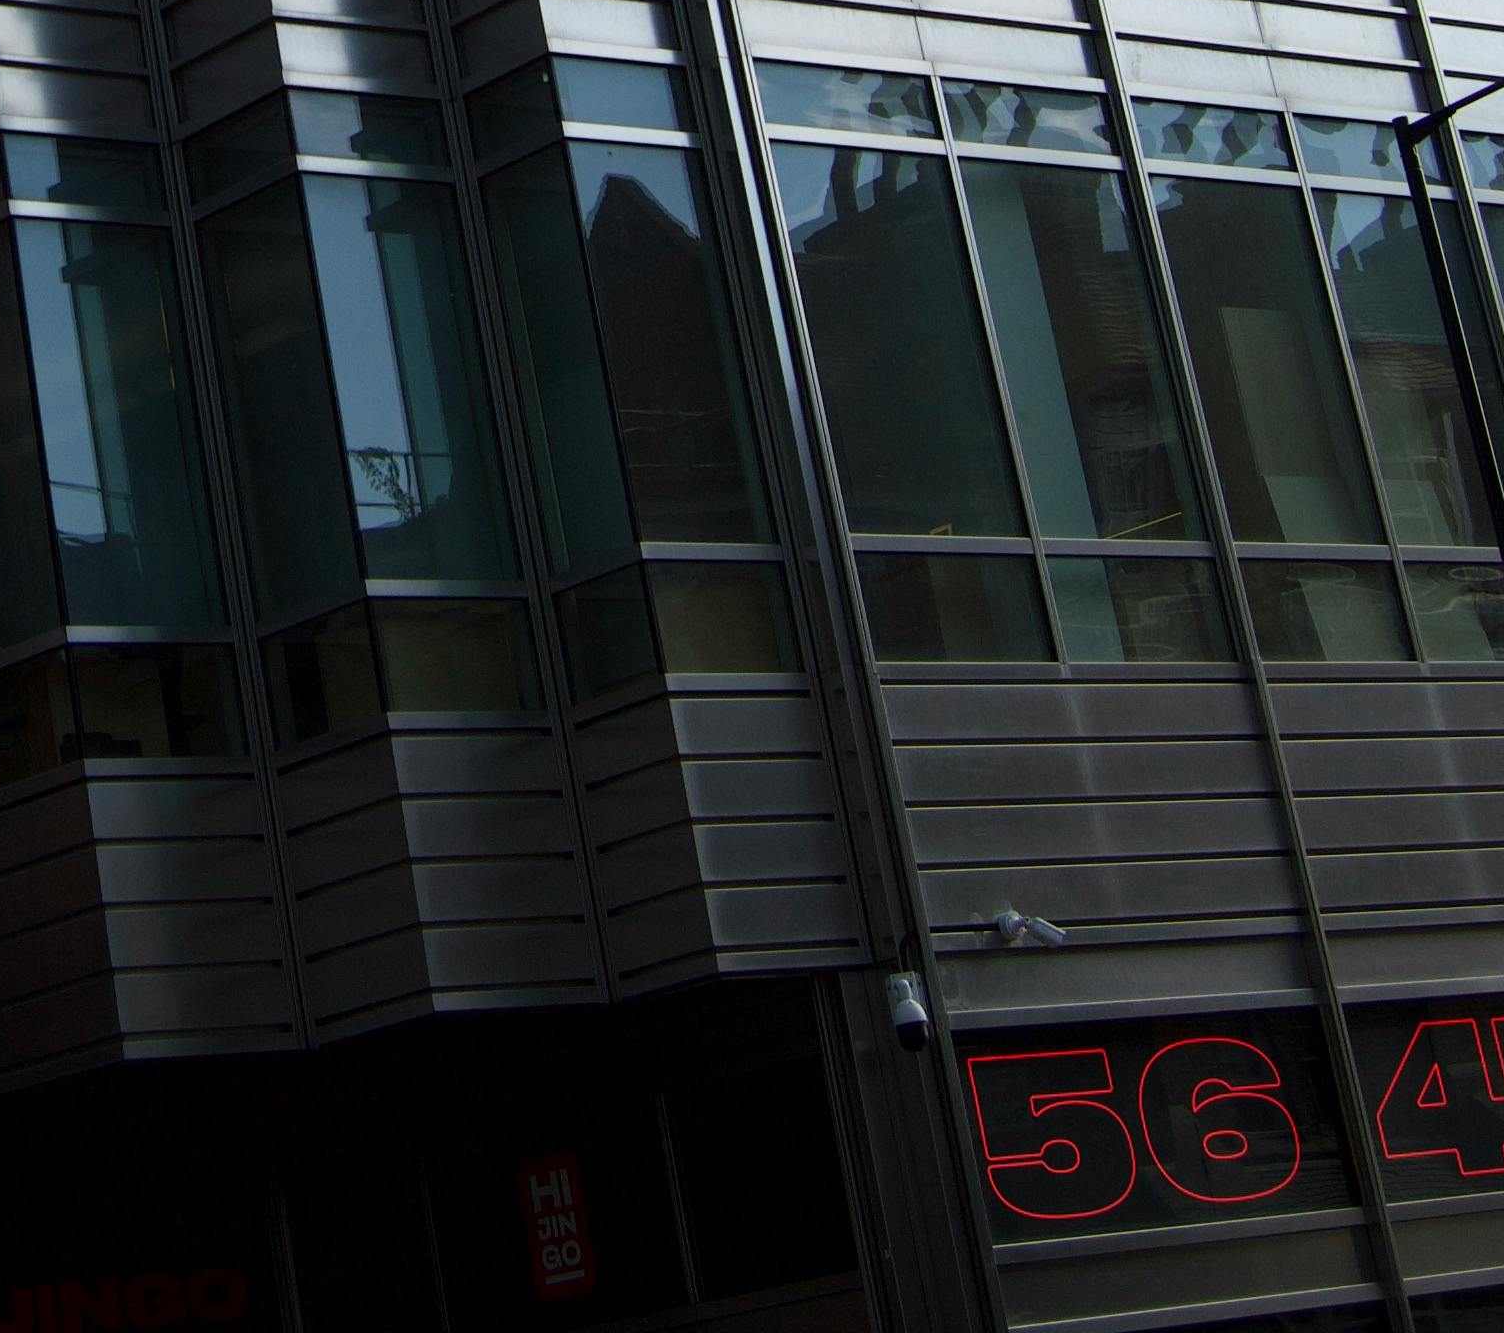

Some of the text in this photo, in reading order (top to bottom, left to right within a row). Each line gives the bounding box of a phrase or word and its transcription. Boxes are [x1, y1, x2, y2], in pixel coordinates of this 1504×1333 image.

[965, 1036, 1302, 1221] 56
[528, 1167, 574, 1214] HI
[536, 1210, 578, 1240] JIN
[541, 1238, 583, 1271] GO
